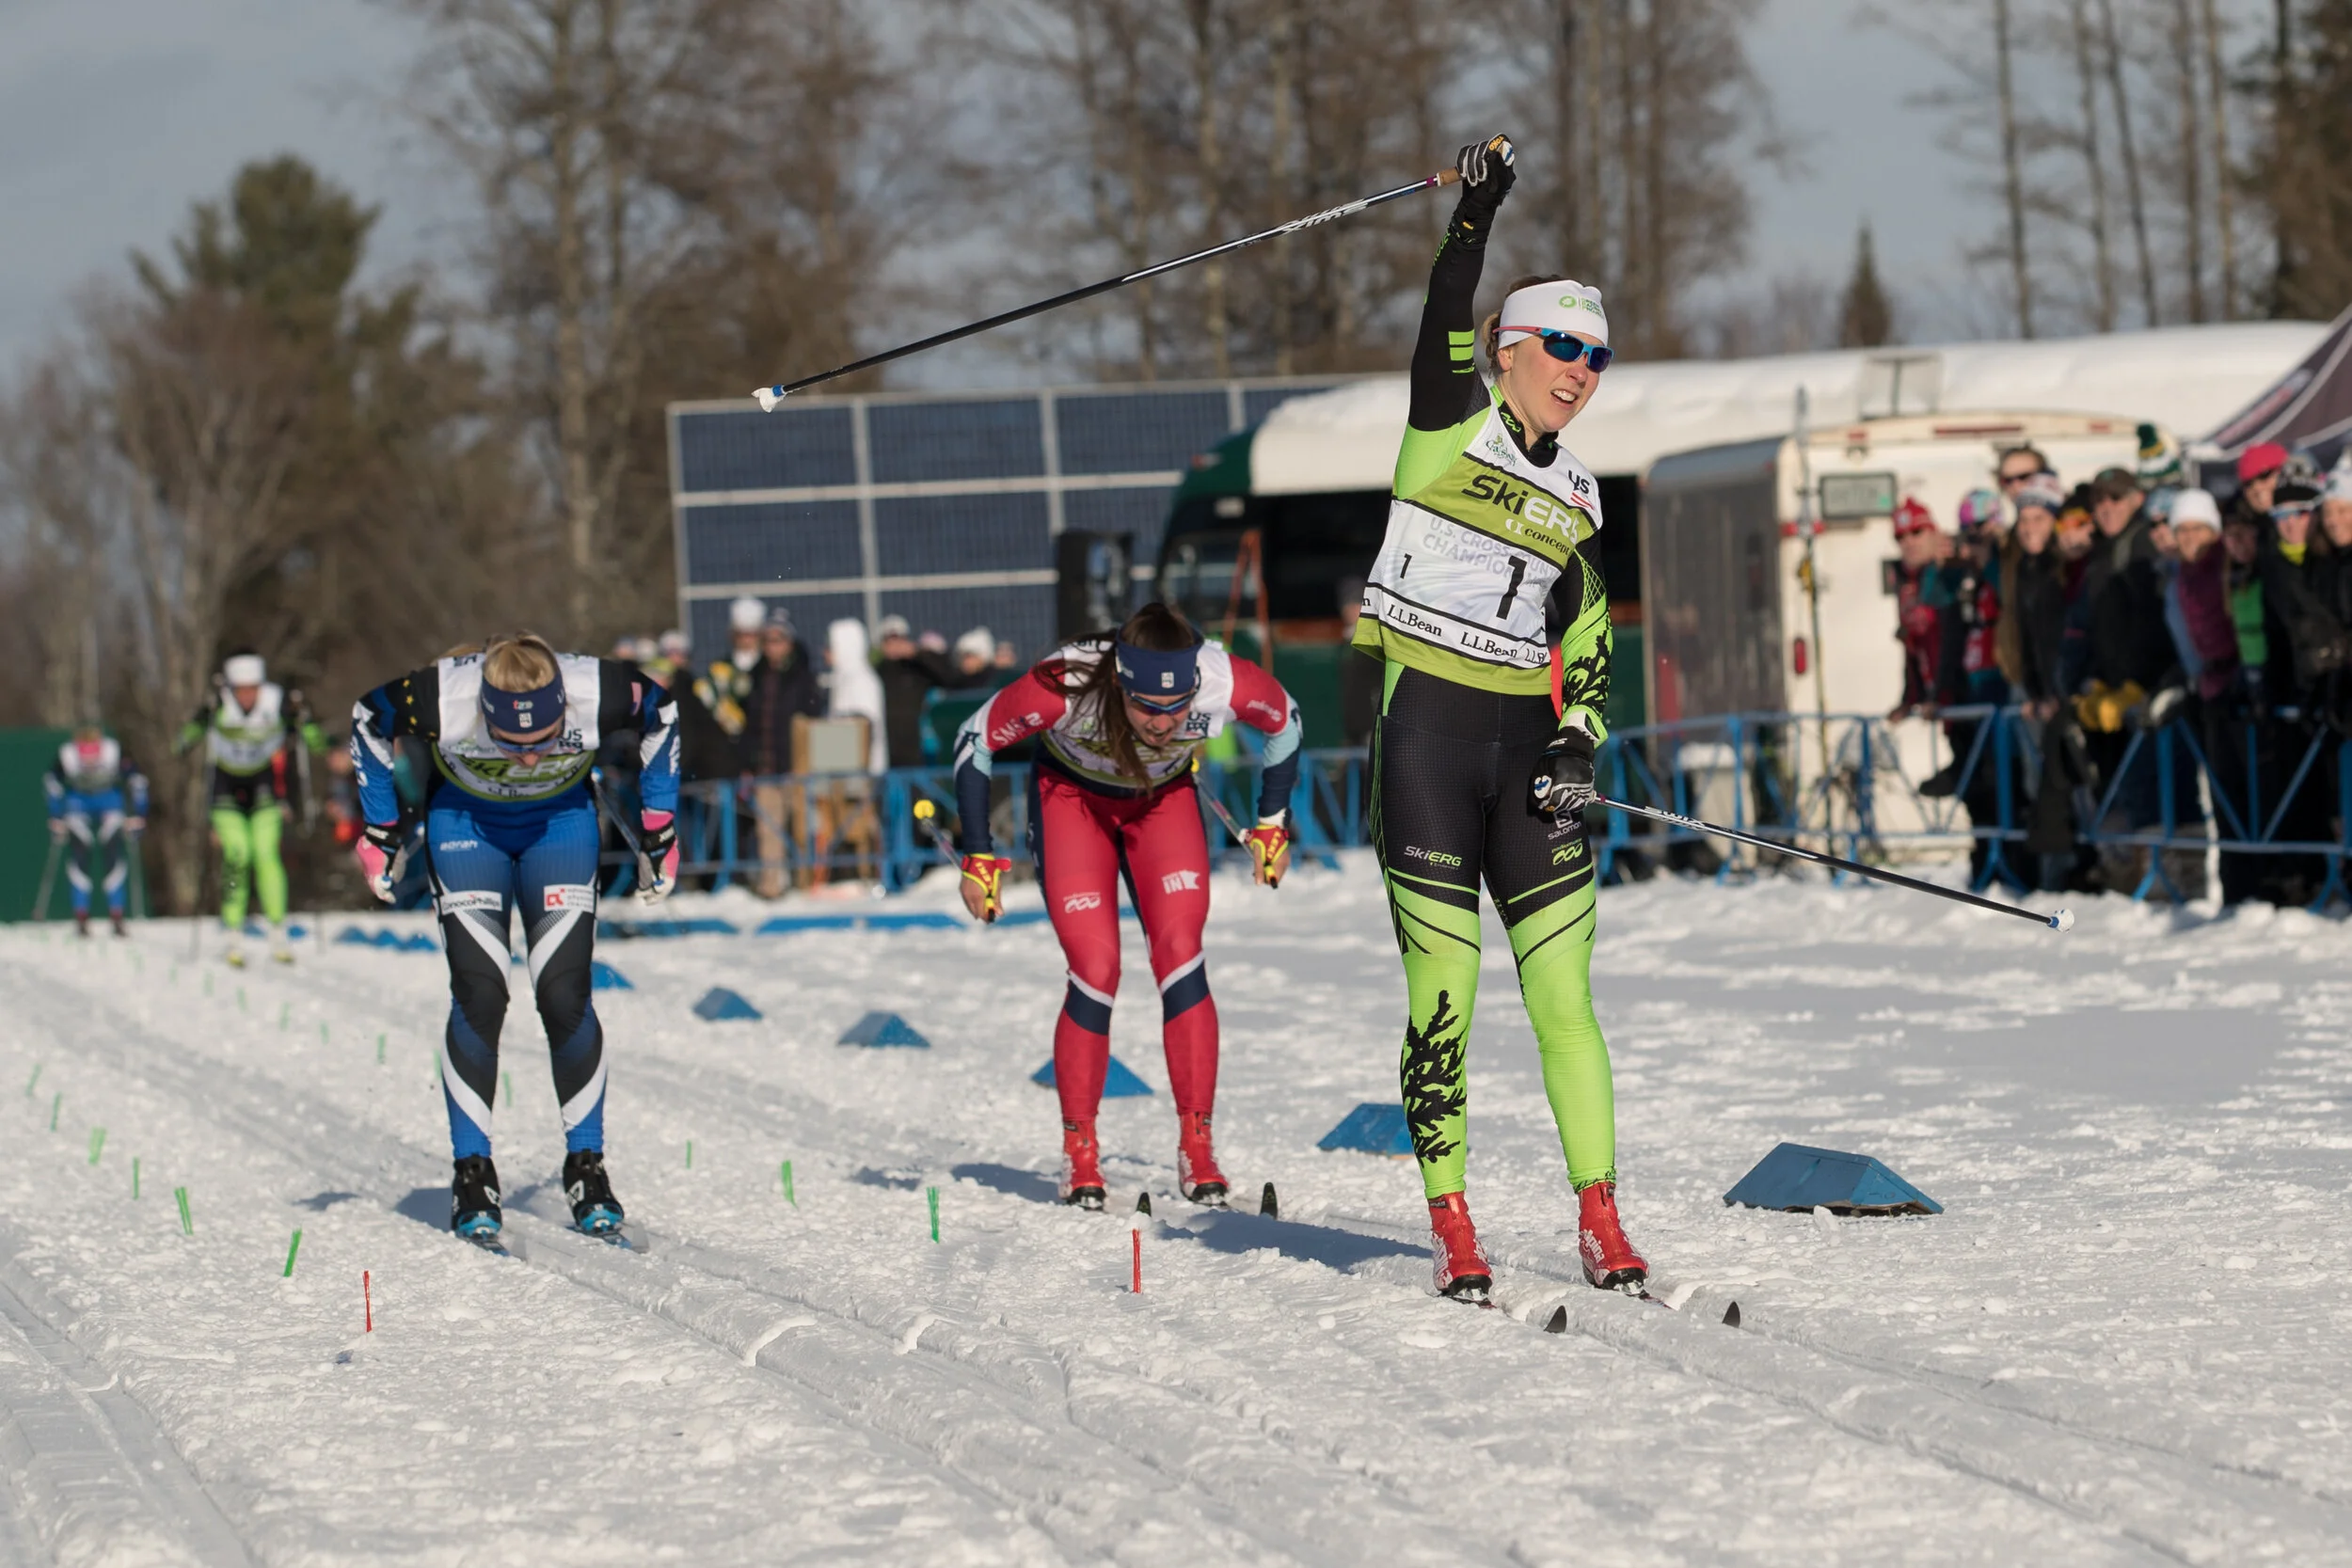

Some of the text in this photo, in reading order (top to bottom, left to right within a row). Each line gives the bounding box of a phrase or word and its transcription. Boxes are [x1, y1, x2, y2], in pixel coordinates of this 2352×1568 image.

[1430, 517, 1456, 539] U.S.
[1460, 530, 1511, 559] CROSS
[1399, 553, 1412, 578] 1
[1496, 555, 1527, 620] 1
[1387, 604, 1442, 637] L.L.Bean
[1460, 631, 1518, 658] L.L.Bean
[1404, 846, 1463, 866] SkiERG
